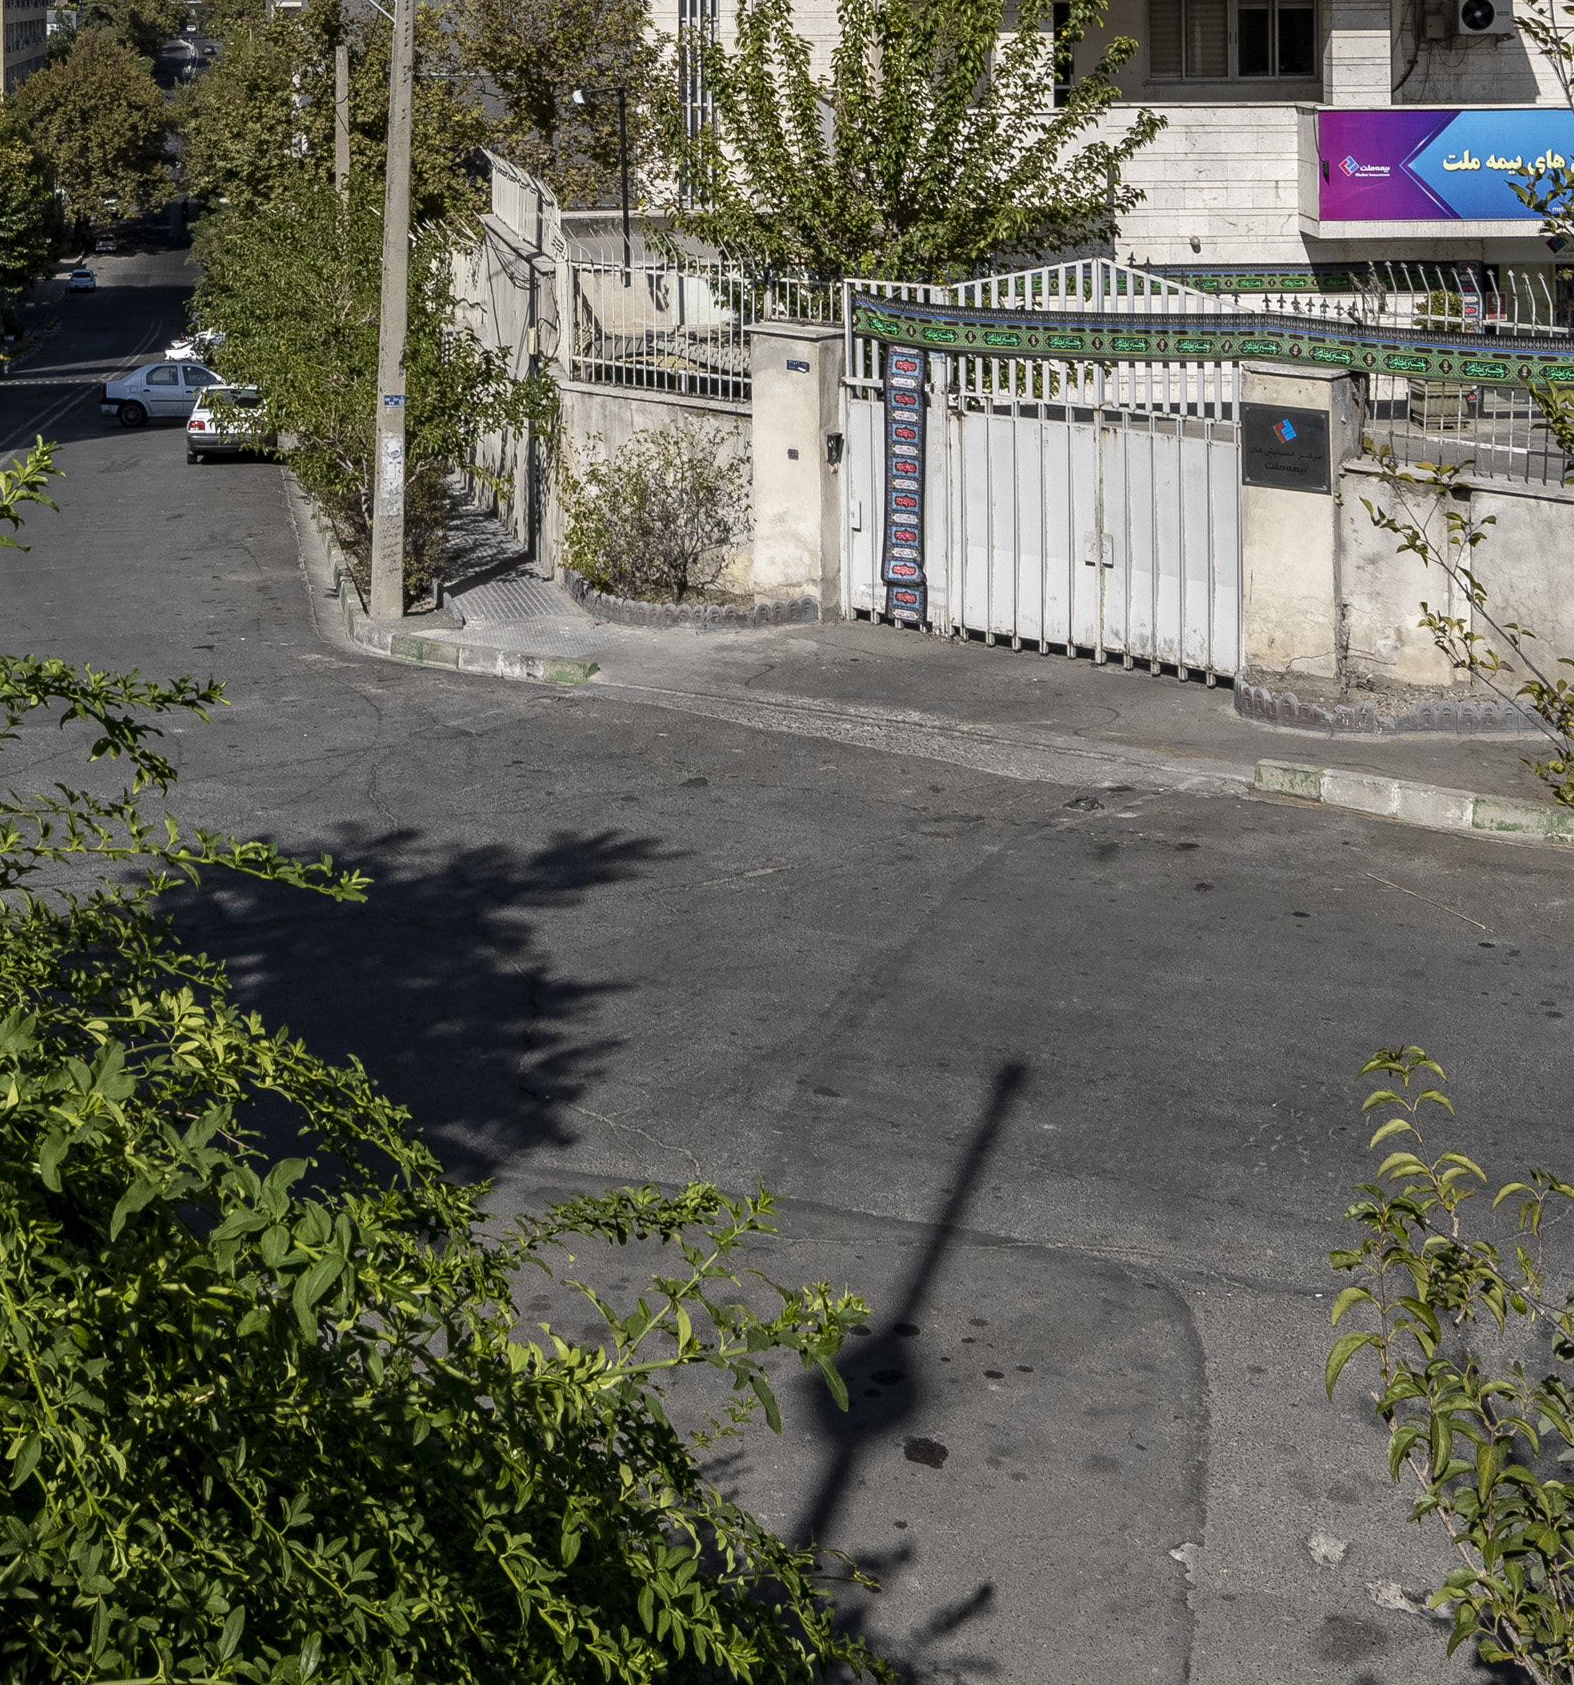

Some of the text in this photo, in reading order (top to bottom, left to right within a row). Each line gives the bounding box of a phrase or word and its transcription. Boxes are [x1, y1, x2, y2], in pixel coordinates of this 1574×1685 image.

[1443, 149, 1481, 171] ملت
[1486, 153, 1522, 176] بیمه
[1528, 149, 1566, 176] های
[1264, 461, 1307, 476] بیمه ملت
